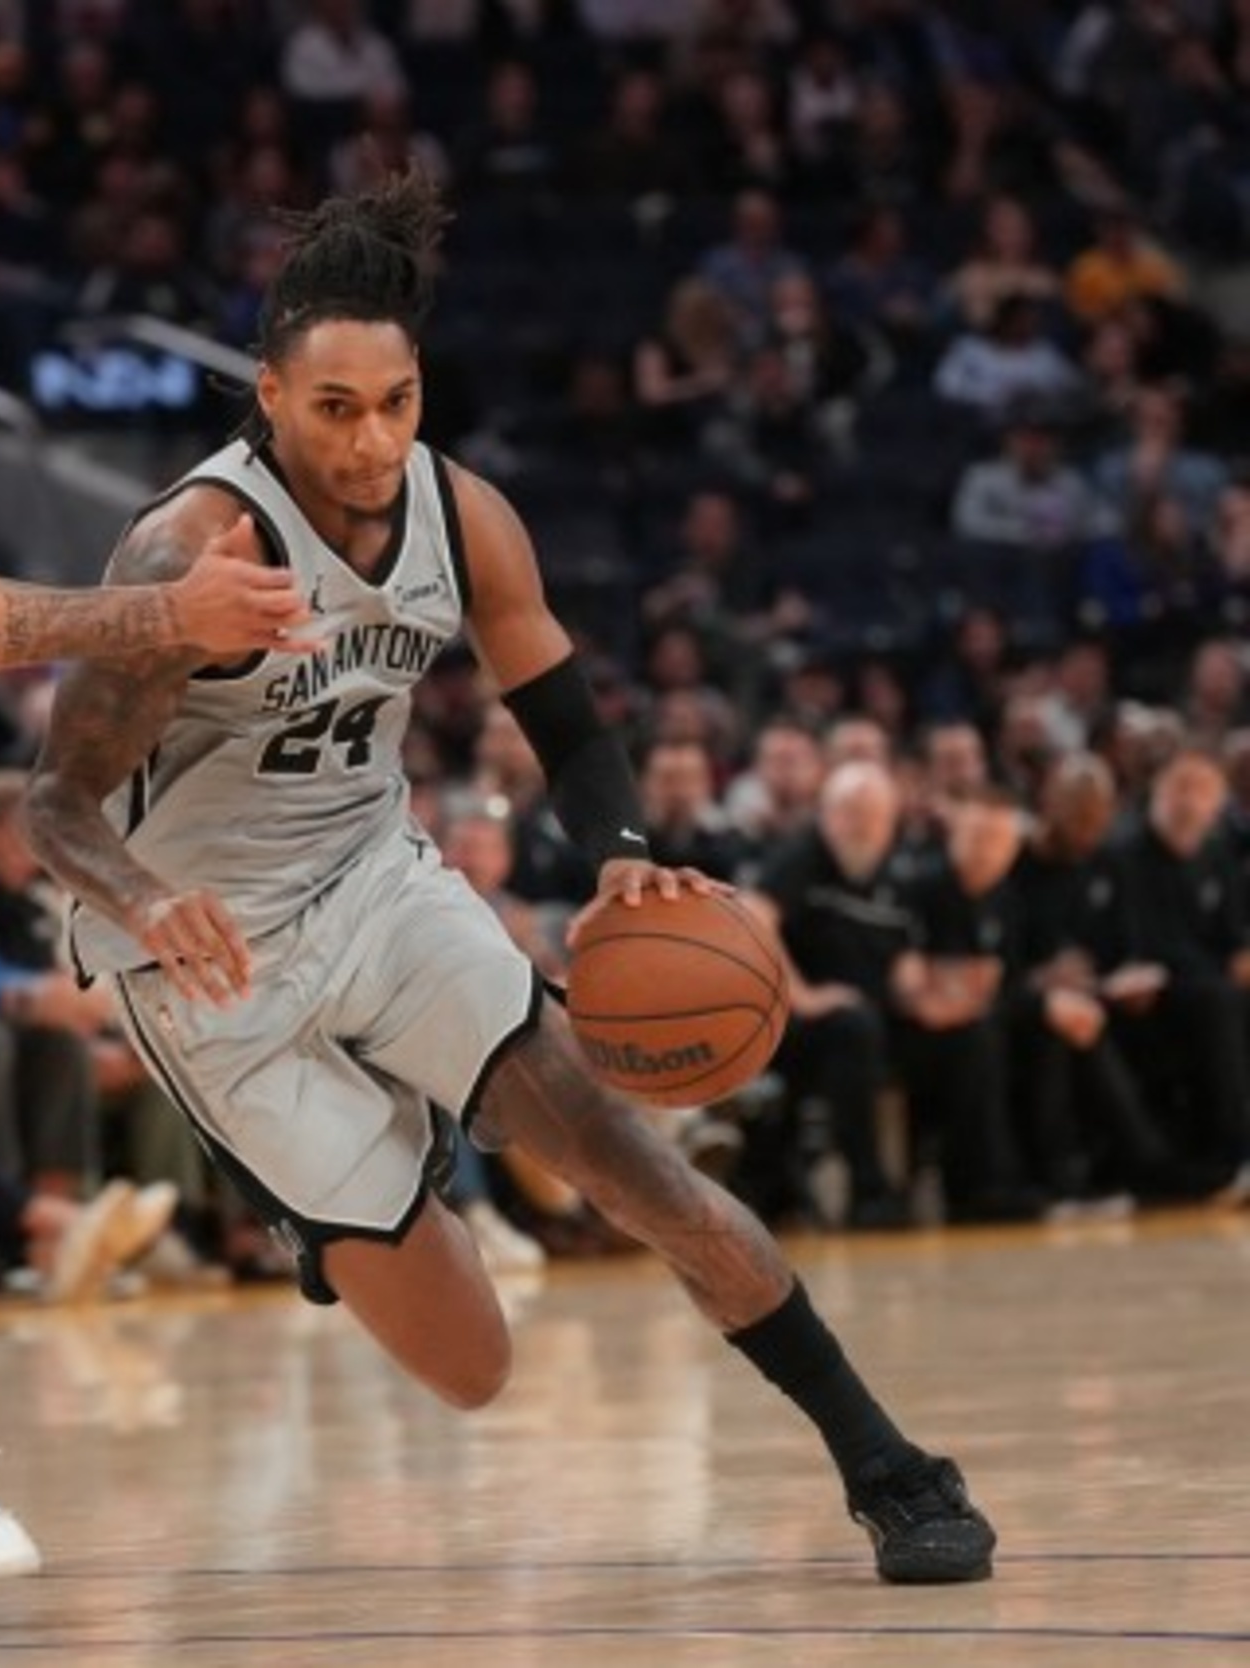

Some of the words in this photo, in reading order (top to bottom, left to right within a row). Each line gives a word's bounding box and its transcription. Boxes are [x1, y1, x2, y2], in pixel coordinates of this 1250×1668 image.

[260, 650, 329, 713] SAN
[332, 623, 444, 680] ANTON
[256, 694, 395, 775] 24
